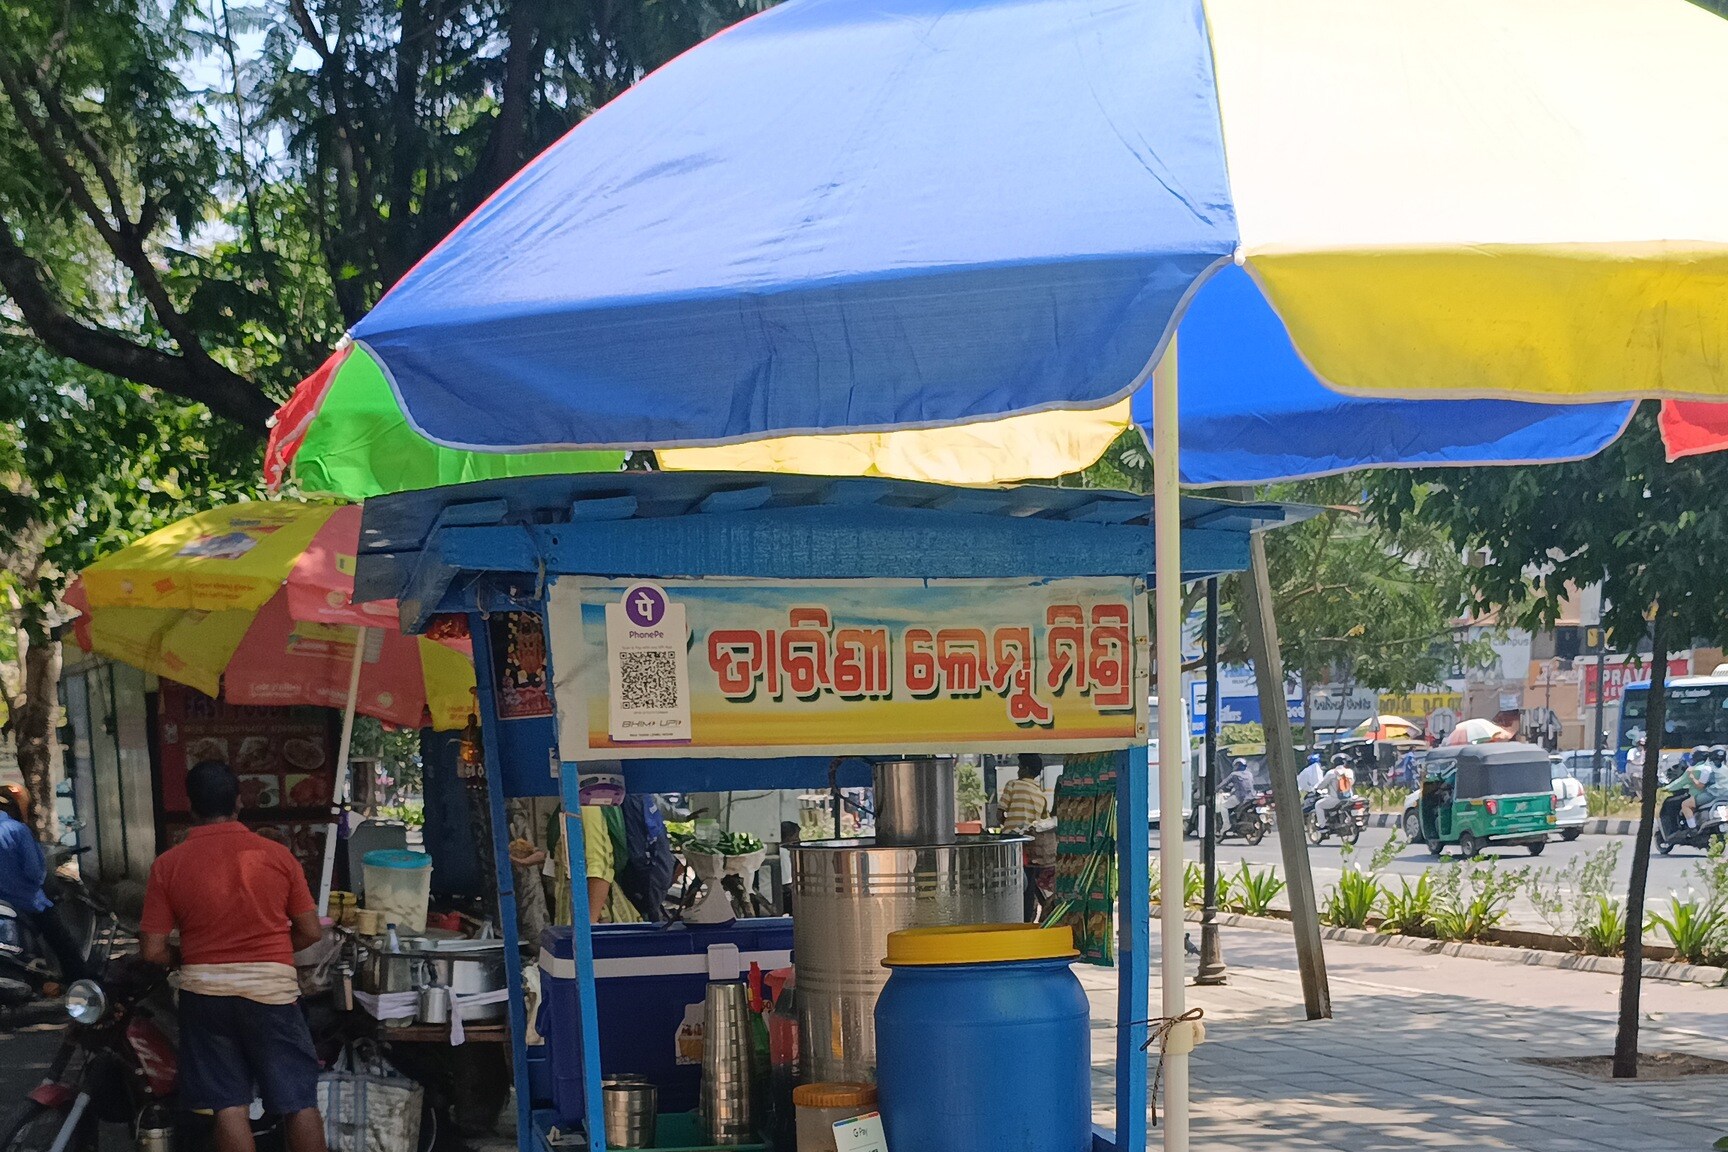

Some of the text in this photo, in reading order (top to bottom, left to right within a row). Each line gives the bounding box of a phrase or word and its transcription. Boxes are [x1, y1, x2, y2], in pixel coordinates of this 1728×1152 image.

[635, 591, 655, 621] पे
[629, 630, 665, 639] PhonePe
[708, 607, 887, 694] ତାରିଣୀ
[622, 719, 679, 728] BHIM UPI
